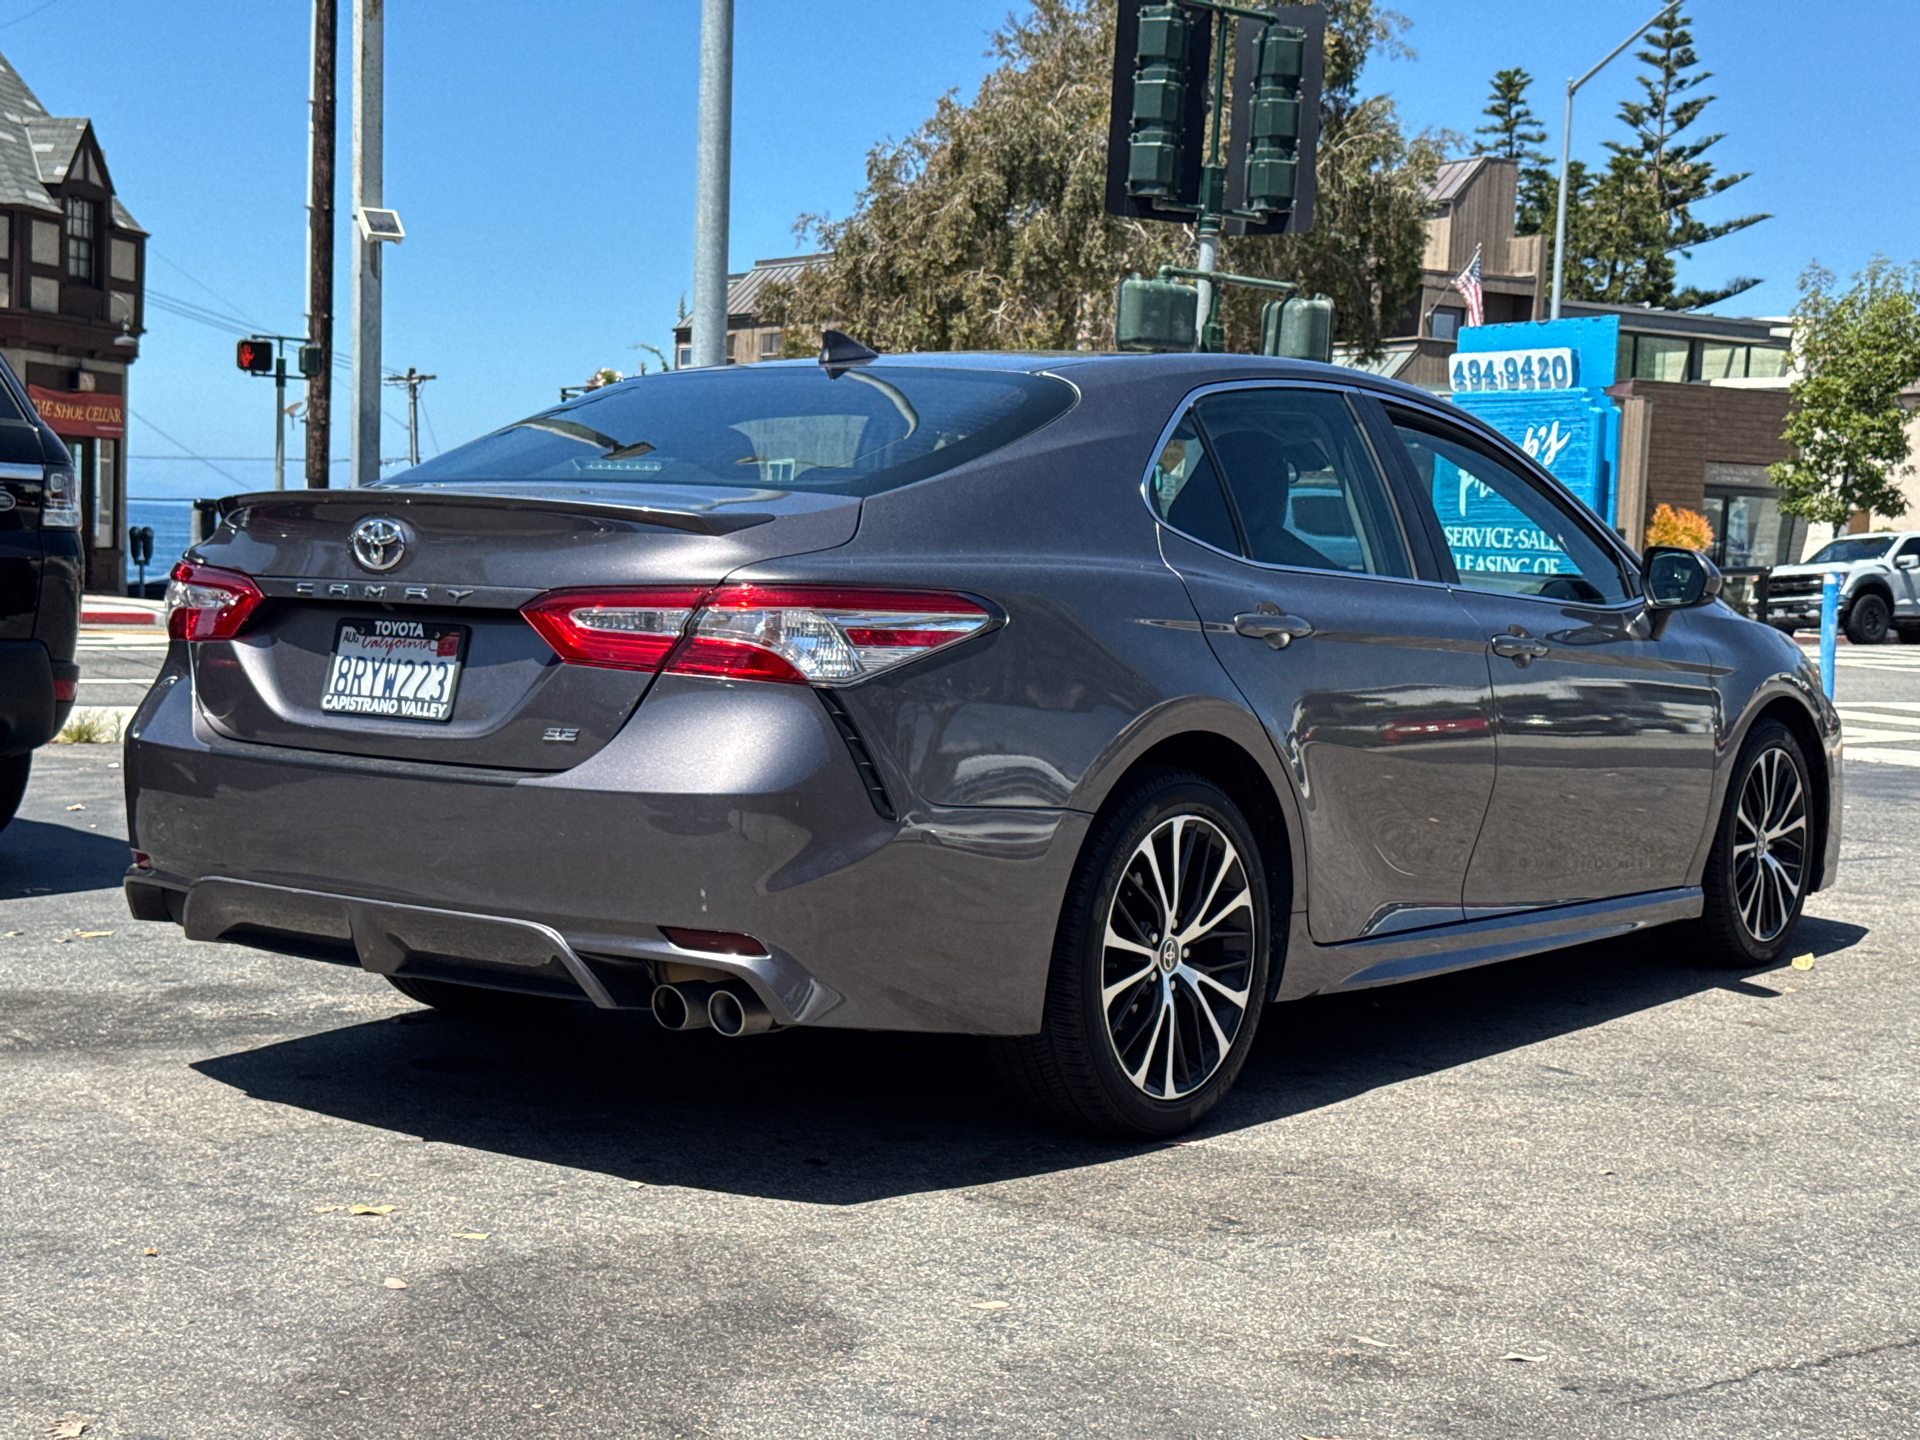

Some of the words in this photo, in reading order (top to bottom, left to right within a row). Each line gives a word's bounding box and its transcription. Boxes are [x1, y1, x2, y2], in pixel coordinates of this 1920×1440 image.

[54, 403, 85, 420] SHOE
[86, 405, 123, 423] CELLAR
[296, 582, 474, 604] CAMRY
[343, 631, 360, 643] AUG
[375, 621, 424, 638] TOYOTA
[361, 635, 438, 656] California
[334, 655, 449, 702] 8RYW223
[322, 694, 399, 714] CAPISTRANO
[401, 700, 448, 718] VALLEY
[542, 727, 580, 741] SE
[1106, 814, 1148, 879] YOKOHAMA
